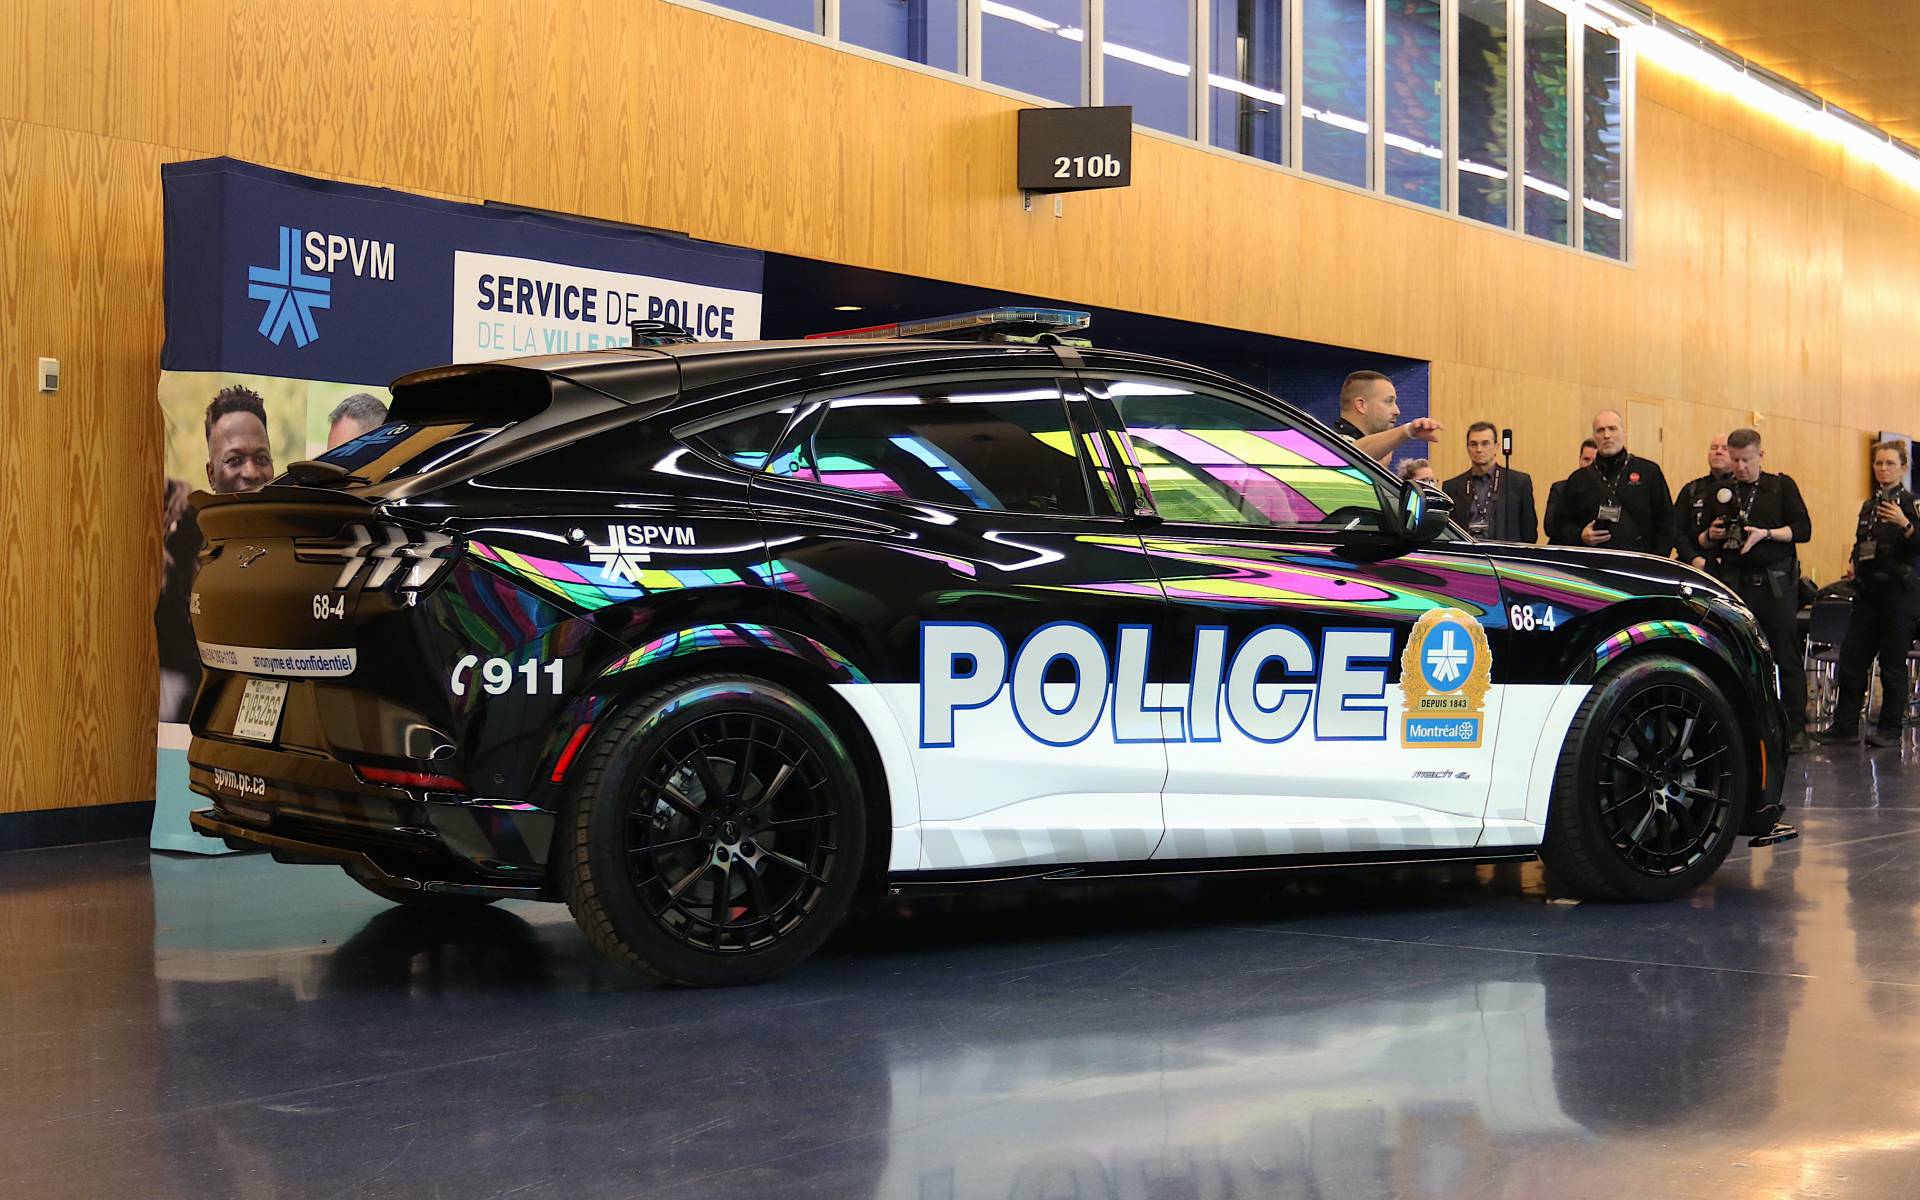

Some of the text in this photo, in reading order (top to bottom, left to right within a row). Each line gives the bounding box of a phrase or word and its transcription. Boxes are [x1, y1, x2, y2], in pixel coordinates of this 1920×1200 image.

[1054, 154, 1121, 178] 210b
[304, 231, 395, 281] SPVM
[477, 274, 735, 341] SERVICE DE POLICE
[478, 321, 504, 350] DE
[513, 325, 537, 353] LA
[627, 525, 696, 546] SPVM
[312, 594, 345, 620] 68-4
[1511, 604, 1556, 632] 68-4
[252, 654, 353, 672] anonyme et confidentiel
[482, 657, 563, 695] 911
[919, 620, 1395, 748] POLICE
[1421, 699, 1467, 709] DEPUIS 1843
[1410, 724, 1458, 738] Montréal
[214, 767, 266, 797] spvm.qc.ca
